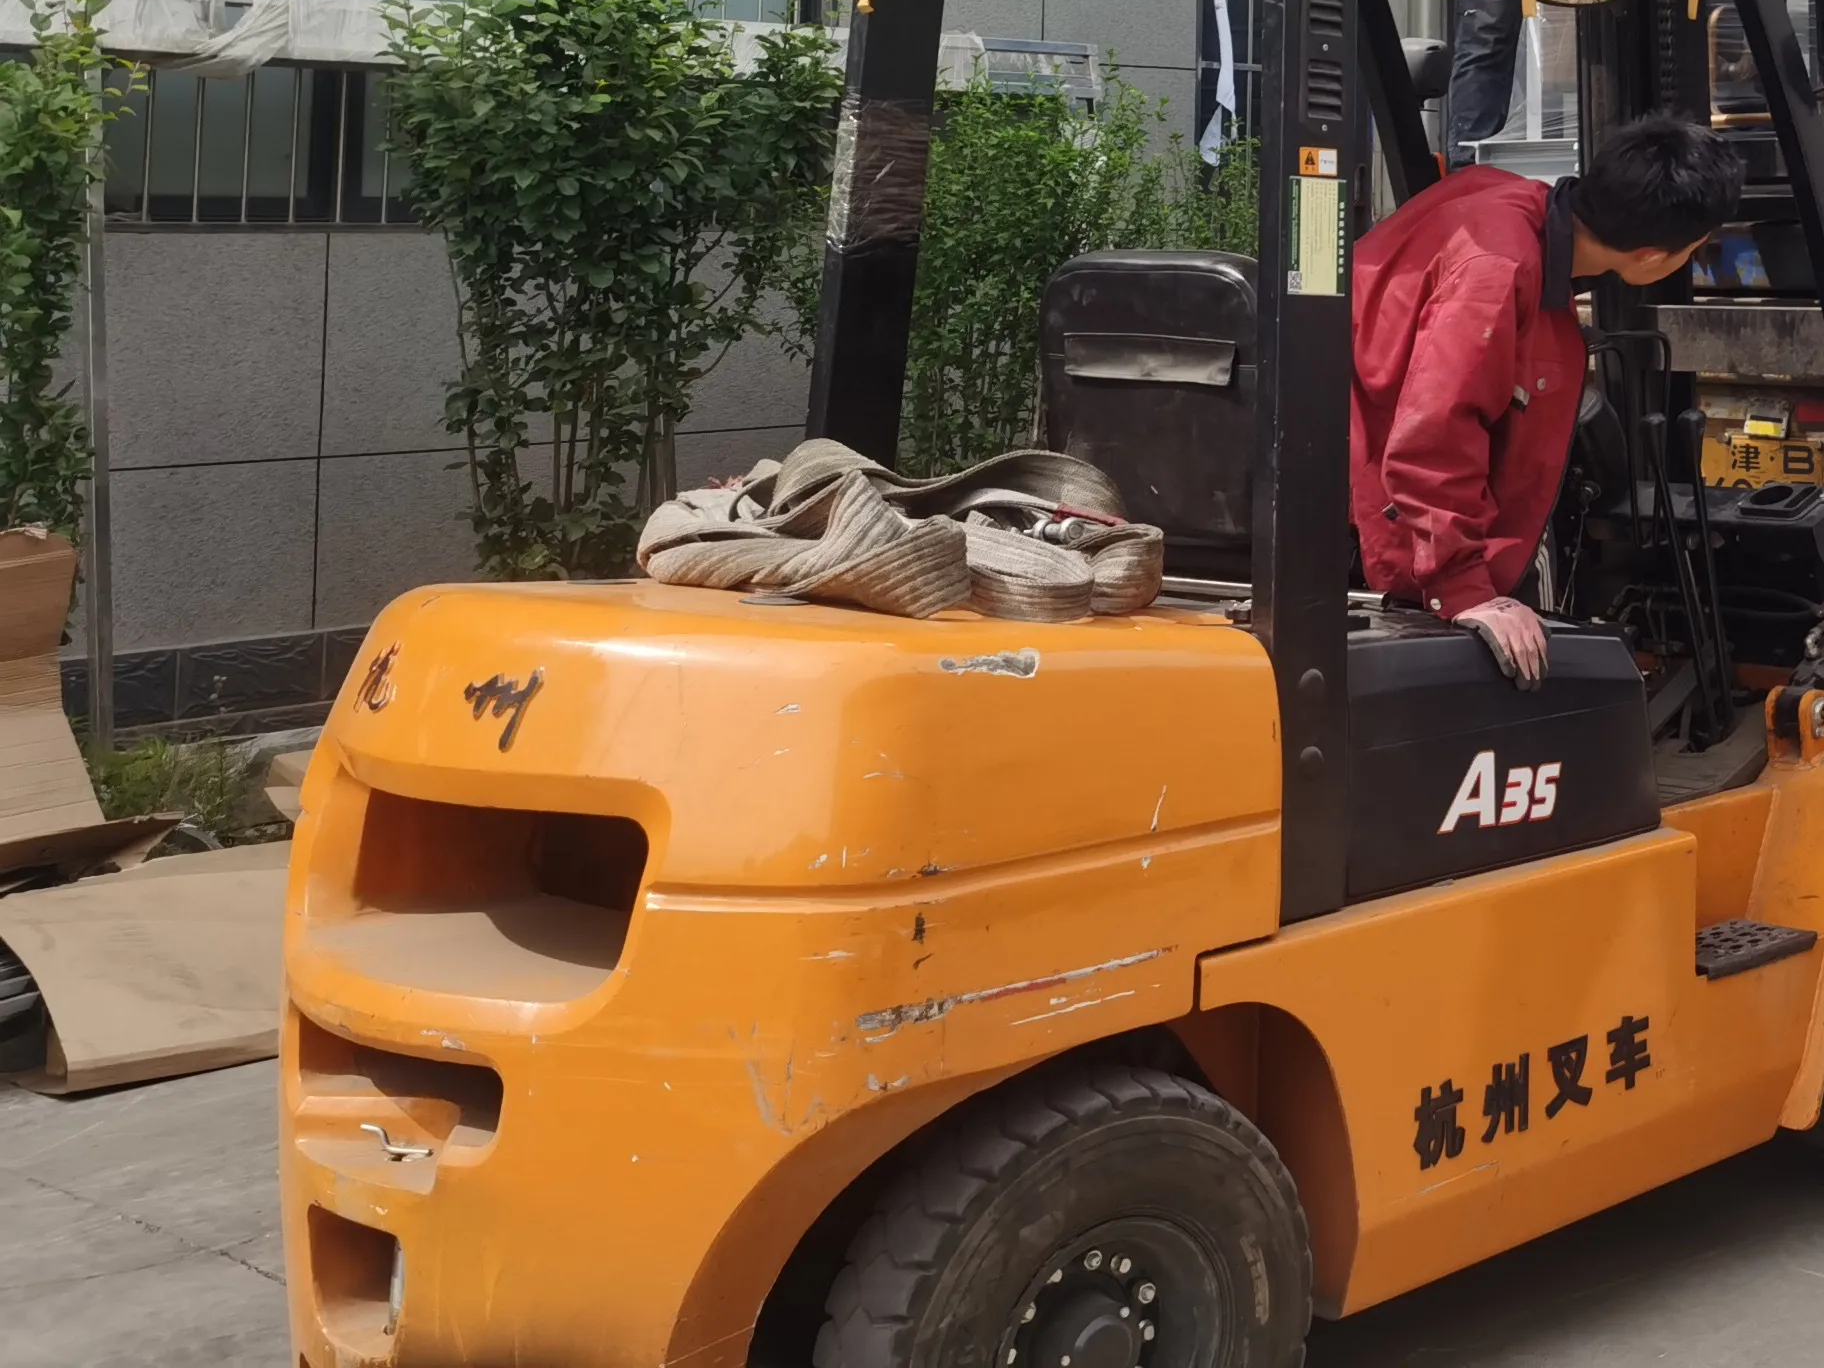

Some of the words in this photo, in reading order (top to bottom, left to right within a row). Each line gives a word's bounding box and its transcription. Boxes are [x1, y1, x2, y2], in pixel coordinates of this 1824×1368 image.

[1437, 749, 1562, 834] A35
[1413, 1016, 1651, 1170] 杭州叉车
